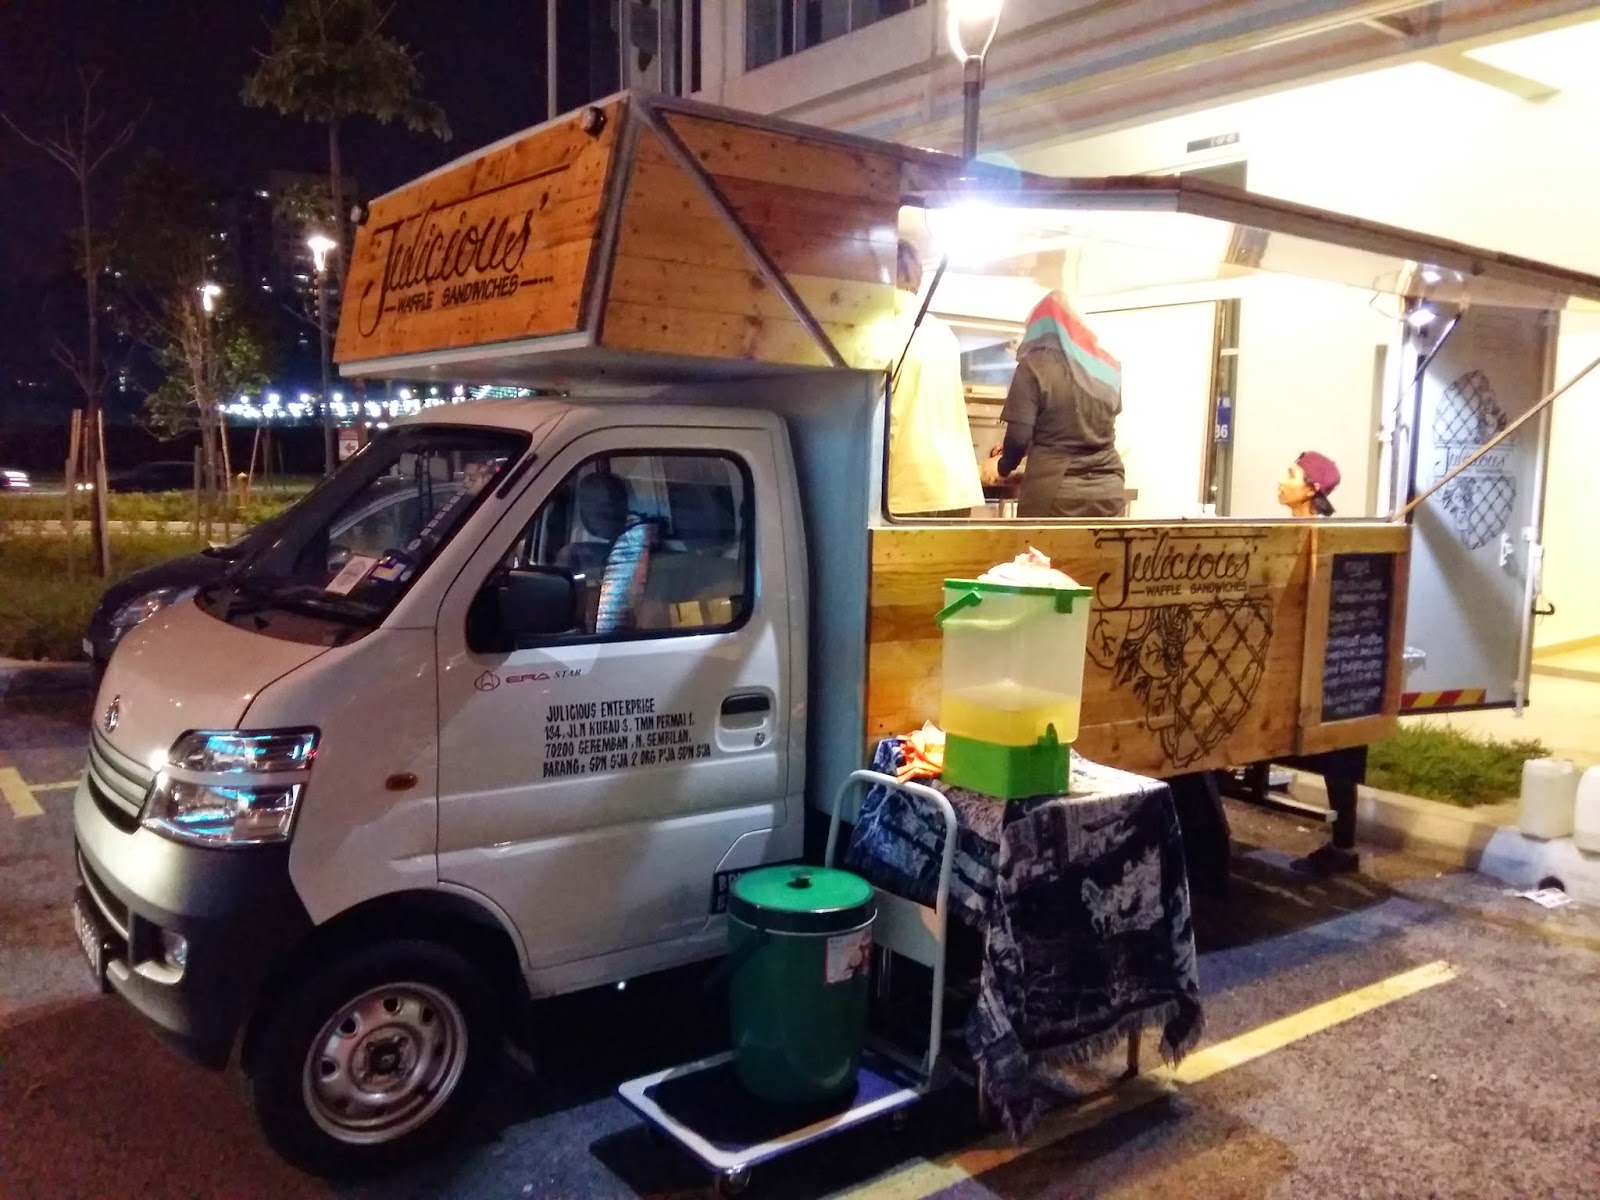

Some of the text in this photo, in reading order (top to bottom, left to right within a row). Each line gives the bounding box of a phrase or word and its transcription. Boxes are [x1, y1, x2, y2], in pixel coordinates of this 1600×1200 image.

[397, 273, 519, 314] WAFFLE SANDWICHES
[1145, 581, 1248, 597] WAFFLE SANDWICHES
[553, 668, 582, 679] STAR
[546, 698, 655, 722] JULICIOUS ENTERPRISE
[567, 722, 586, 738] JLN
[589, 719, 620, 737] KURAU
[634, 715, 654, 731] TMN
[656, 712, 686, 729] PERMAI
[545, 741, 574, 758] 70200
[631, 751, 638, 767] 2
